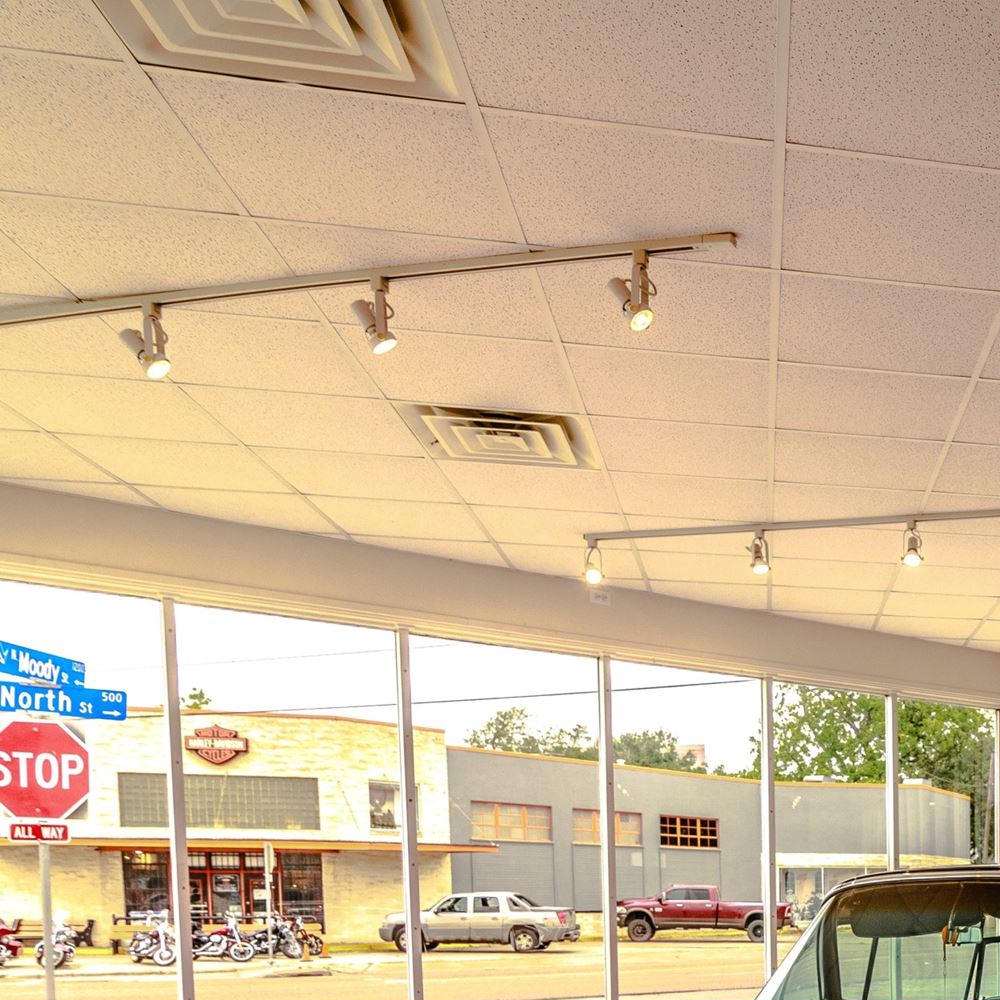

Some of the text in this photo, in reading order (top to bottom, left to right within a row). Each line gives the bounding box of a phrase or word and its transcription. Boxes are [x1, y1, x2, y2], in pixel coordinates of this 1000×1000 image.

[18, 650, 60, 685] Moody
[0, 685, 93, 714] North St
[101, 691, 122, 703] 500
[13, 826, 65, 839] ALL WAY
